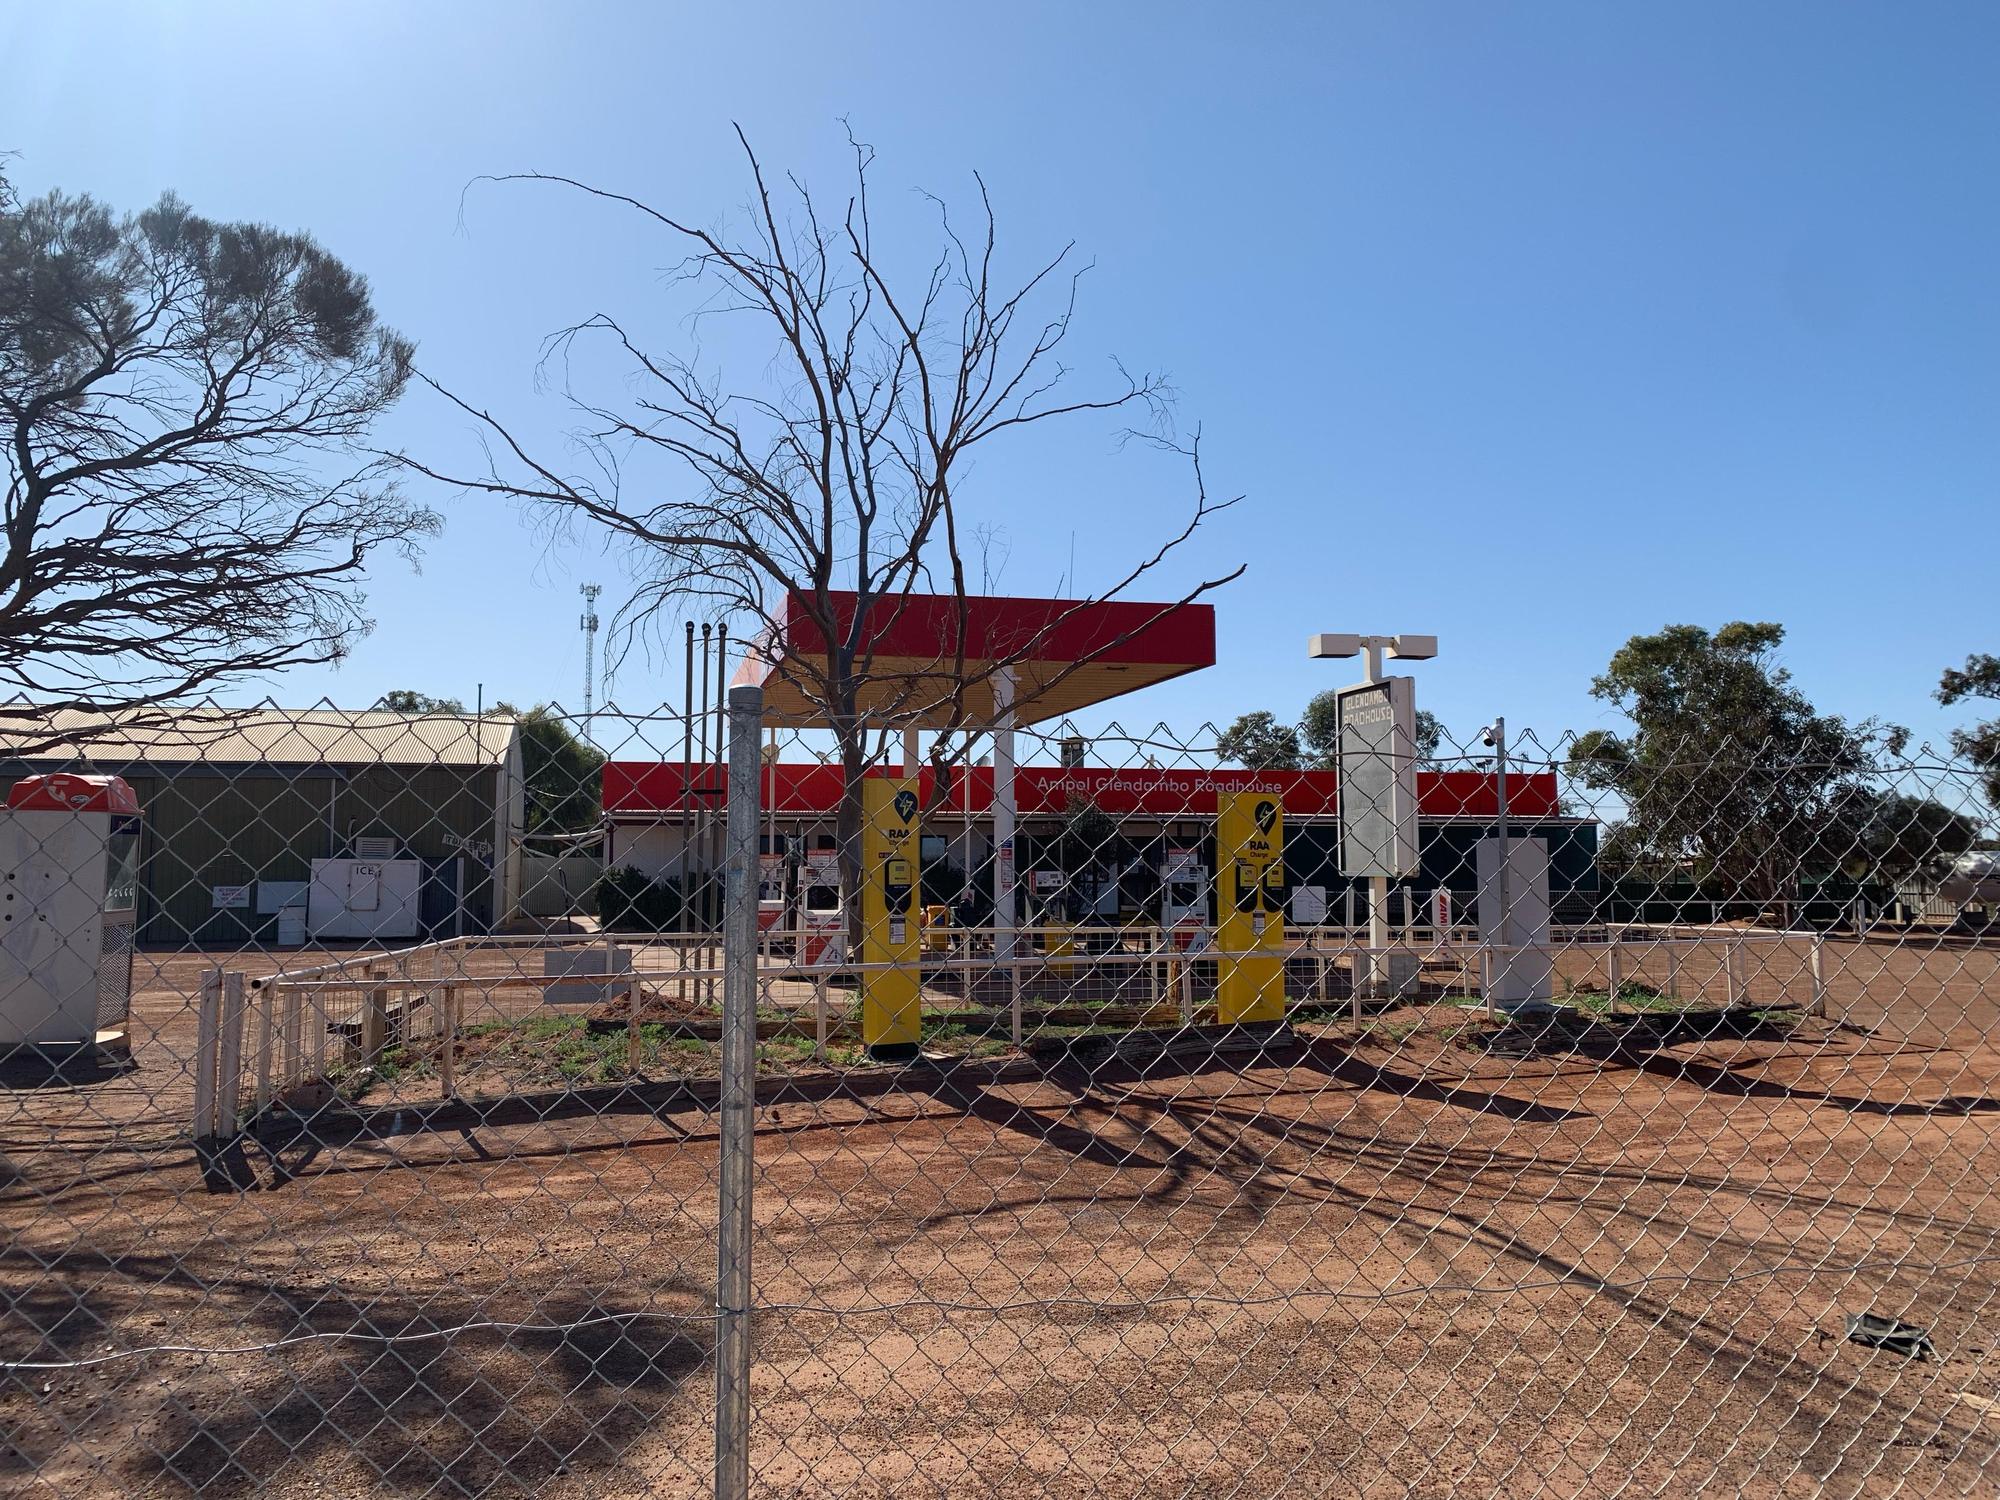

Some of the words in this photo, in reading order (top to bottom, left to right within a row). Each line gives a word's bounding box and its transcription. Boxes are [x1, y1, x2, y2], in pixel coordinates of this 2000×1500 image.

[1345, 689, 1389, 710] GLENDAMBO
[1037, 777, 1090, 794] Ampol
[1096, 777, 1190, 793] Glendambo
[1195, 779, 1282, 793] Roadhouse
[889, 829, 911, 838] RAA
[1250, 841, 1269, 850] RAA
[356, 866, 375, 875] ICE
